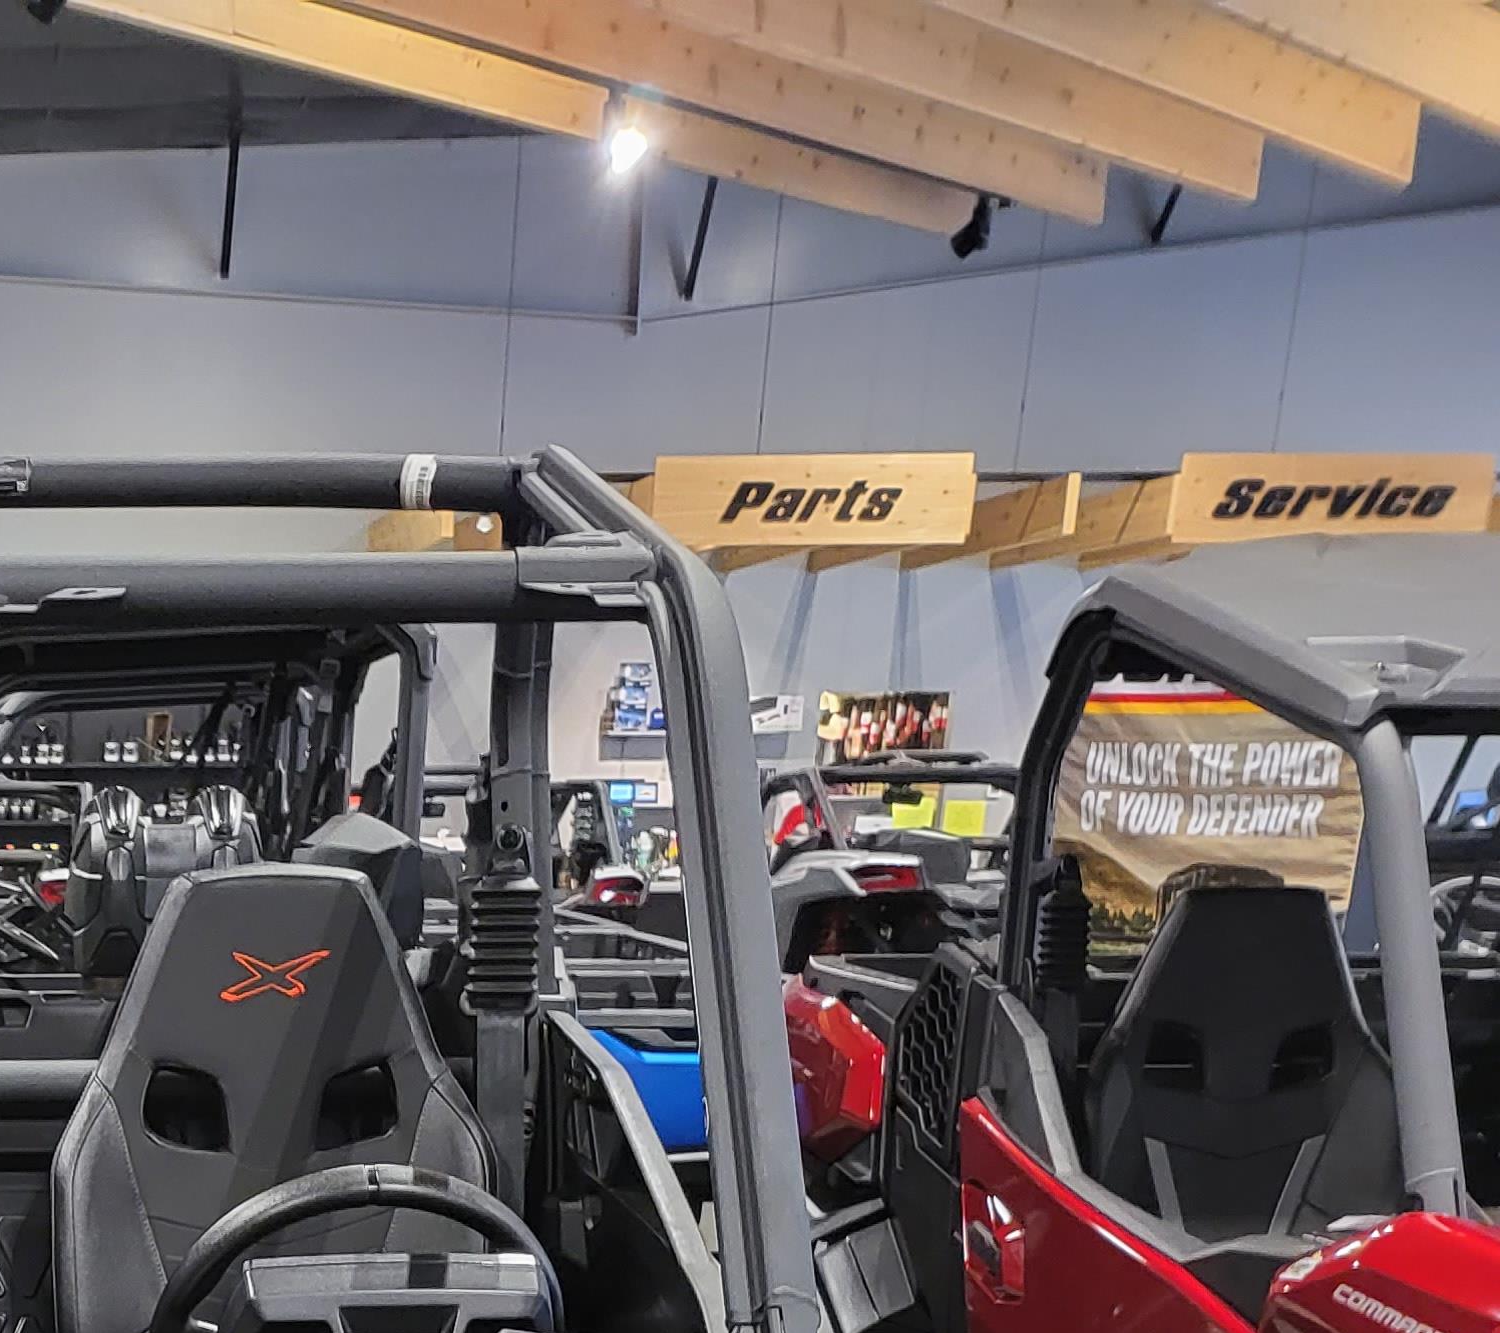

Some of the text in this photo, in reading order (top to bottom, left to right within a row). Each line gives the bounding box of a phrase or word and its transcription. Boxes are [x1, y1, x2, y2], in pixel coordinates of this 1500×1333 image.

[718, 478, 904, 524] Parts
[1211, 477, 1458, 520] Service
[1086, 740, 1344, 788] UNLOCK THE POWER
[1080, 789, 1325, 838] OF YOUR DEFENDER
